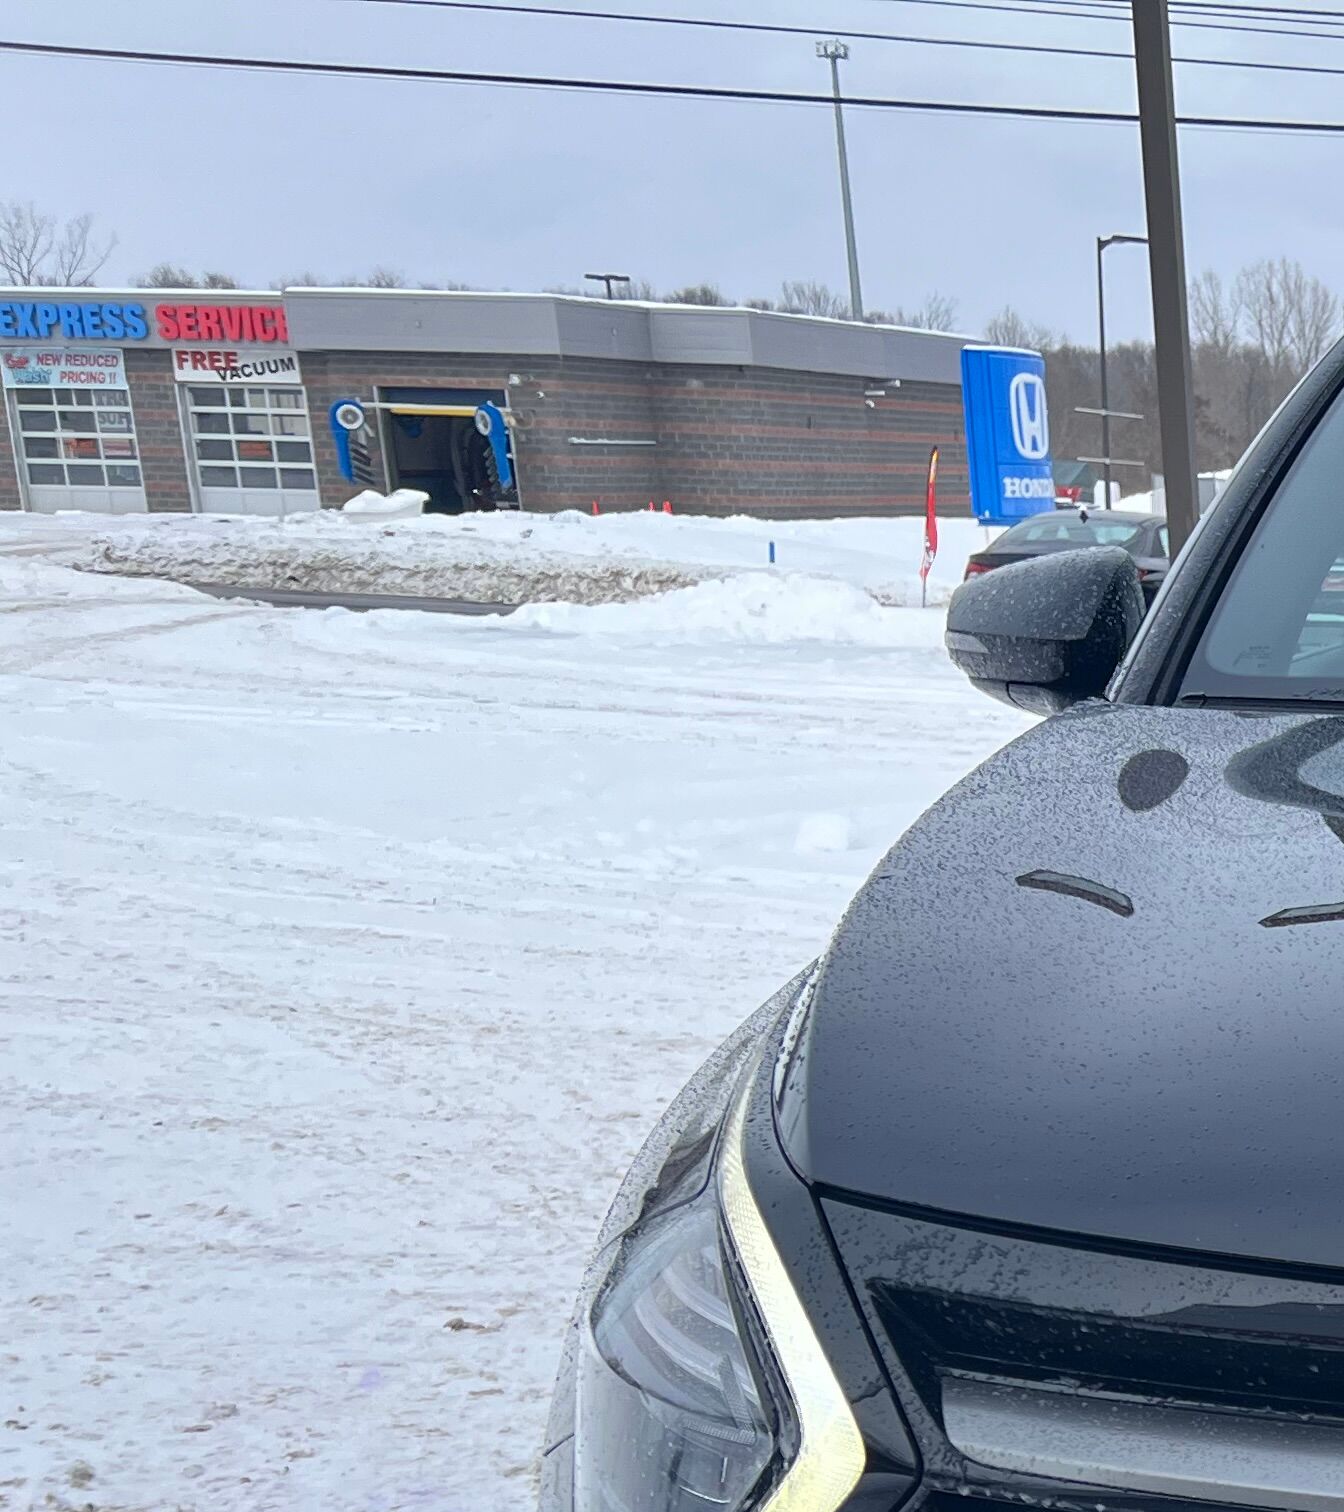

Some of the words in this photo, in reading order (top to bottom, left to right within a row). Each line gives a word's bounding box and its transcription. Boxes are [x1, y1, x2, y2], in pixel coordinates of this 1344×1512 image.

[0, 302, 148, 339] EXPRESS
[36, 353, 62, 366] NEW
[65, 354, 119, 368] REDUCED
[175, 350, 238, 371] FREE
[216, 357, 296, 381] VACUUM
[59, 371, 106, 384] PRICING
